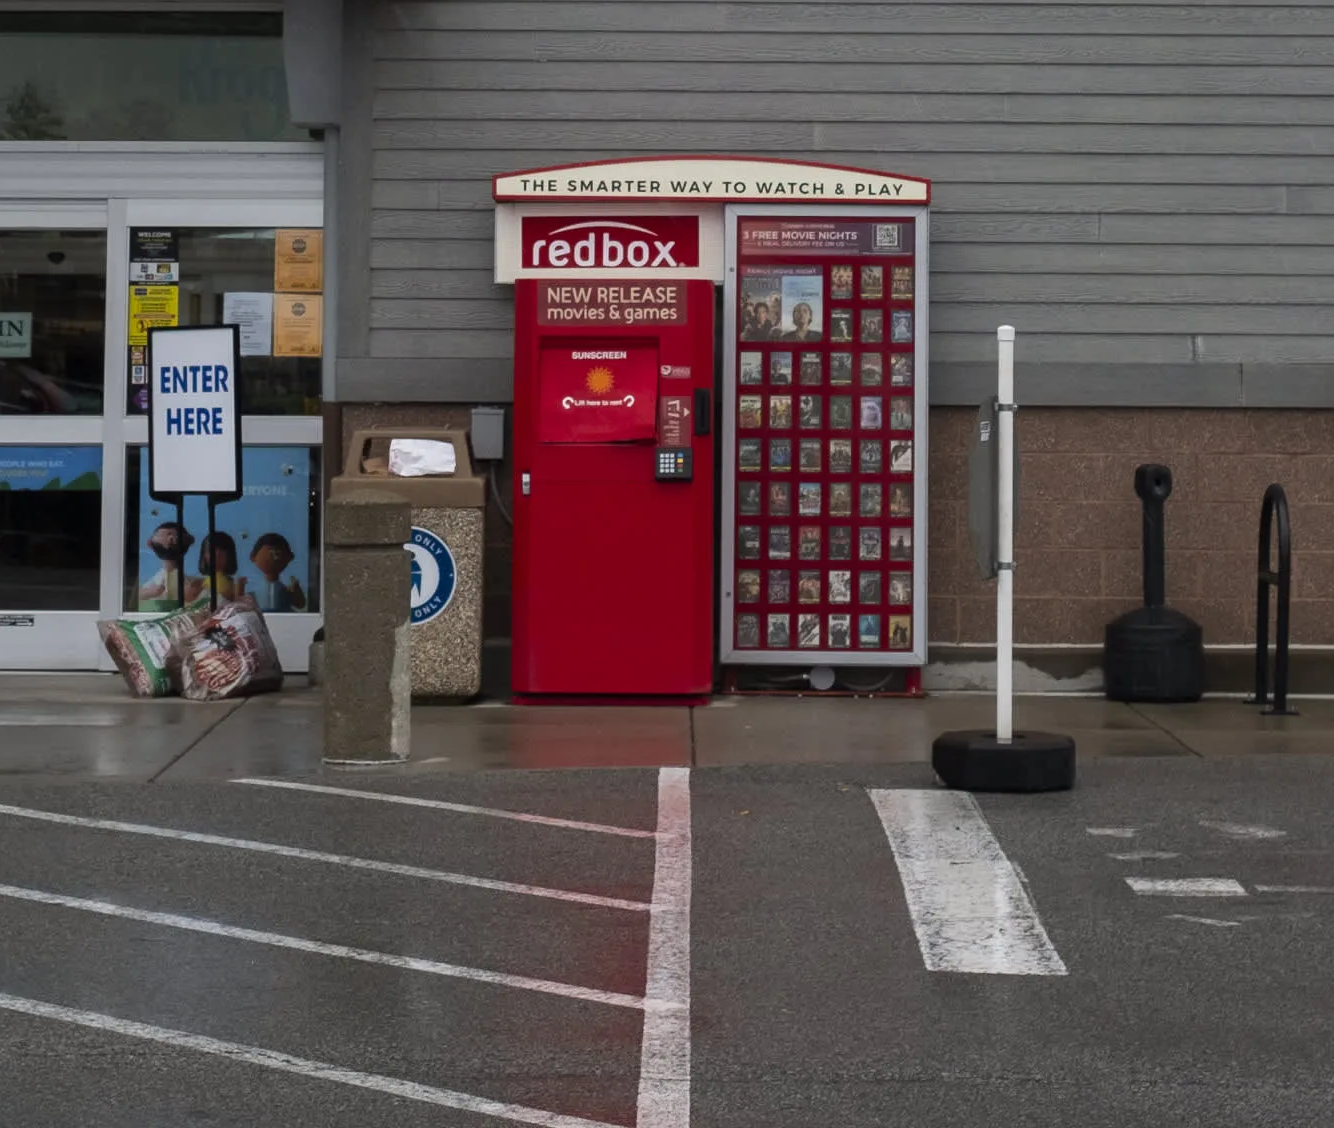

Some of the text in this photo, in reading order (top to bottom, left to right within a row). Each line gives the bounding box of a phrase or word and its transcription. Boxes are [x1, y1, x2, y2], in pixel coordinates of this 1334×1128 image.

[521, 179, 904, 196] THE SMARTER WAY TO WATCH & PLAY
[752, 231, 779, 240] FREE
[781, 231, 816, 240] MOVIE
[818, 231, 858, 240] NIGHTS
[532, 232, 678, 267] redbox
[547, 287, 677, 303] NEW RELEASE
[547, 306, 677, 324] movies & games
[571, 351, 627, 360] SUNSCREEN
[160, 365, 229, 394] ENTER
[166, 407, 223, 435] HERE
[414, 534, 443, 555] ONLY
[414, 596, 443, 618] ONLY
